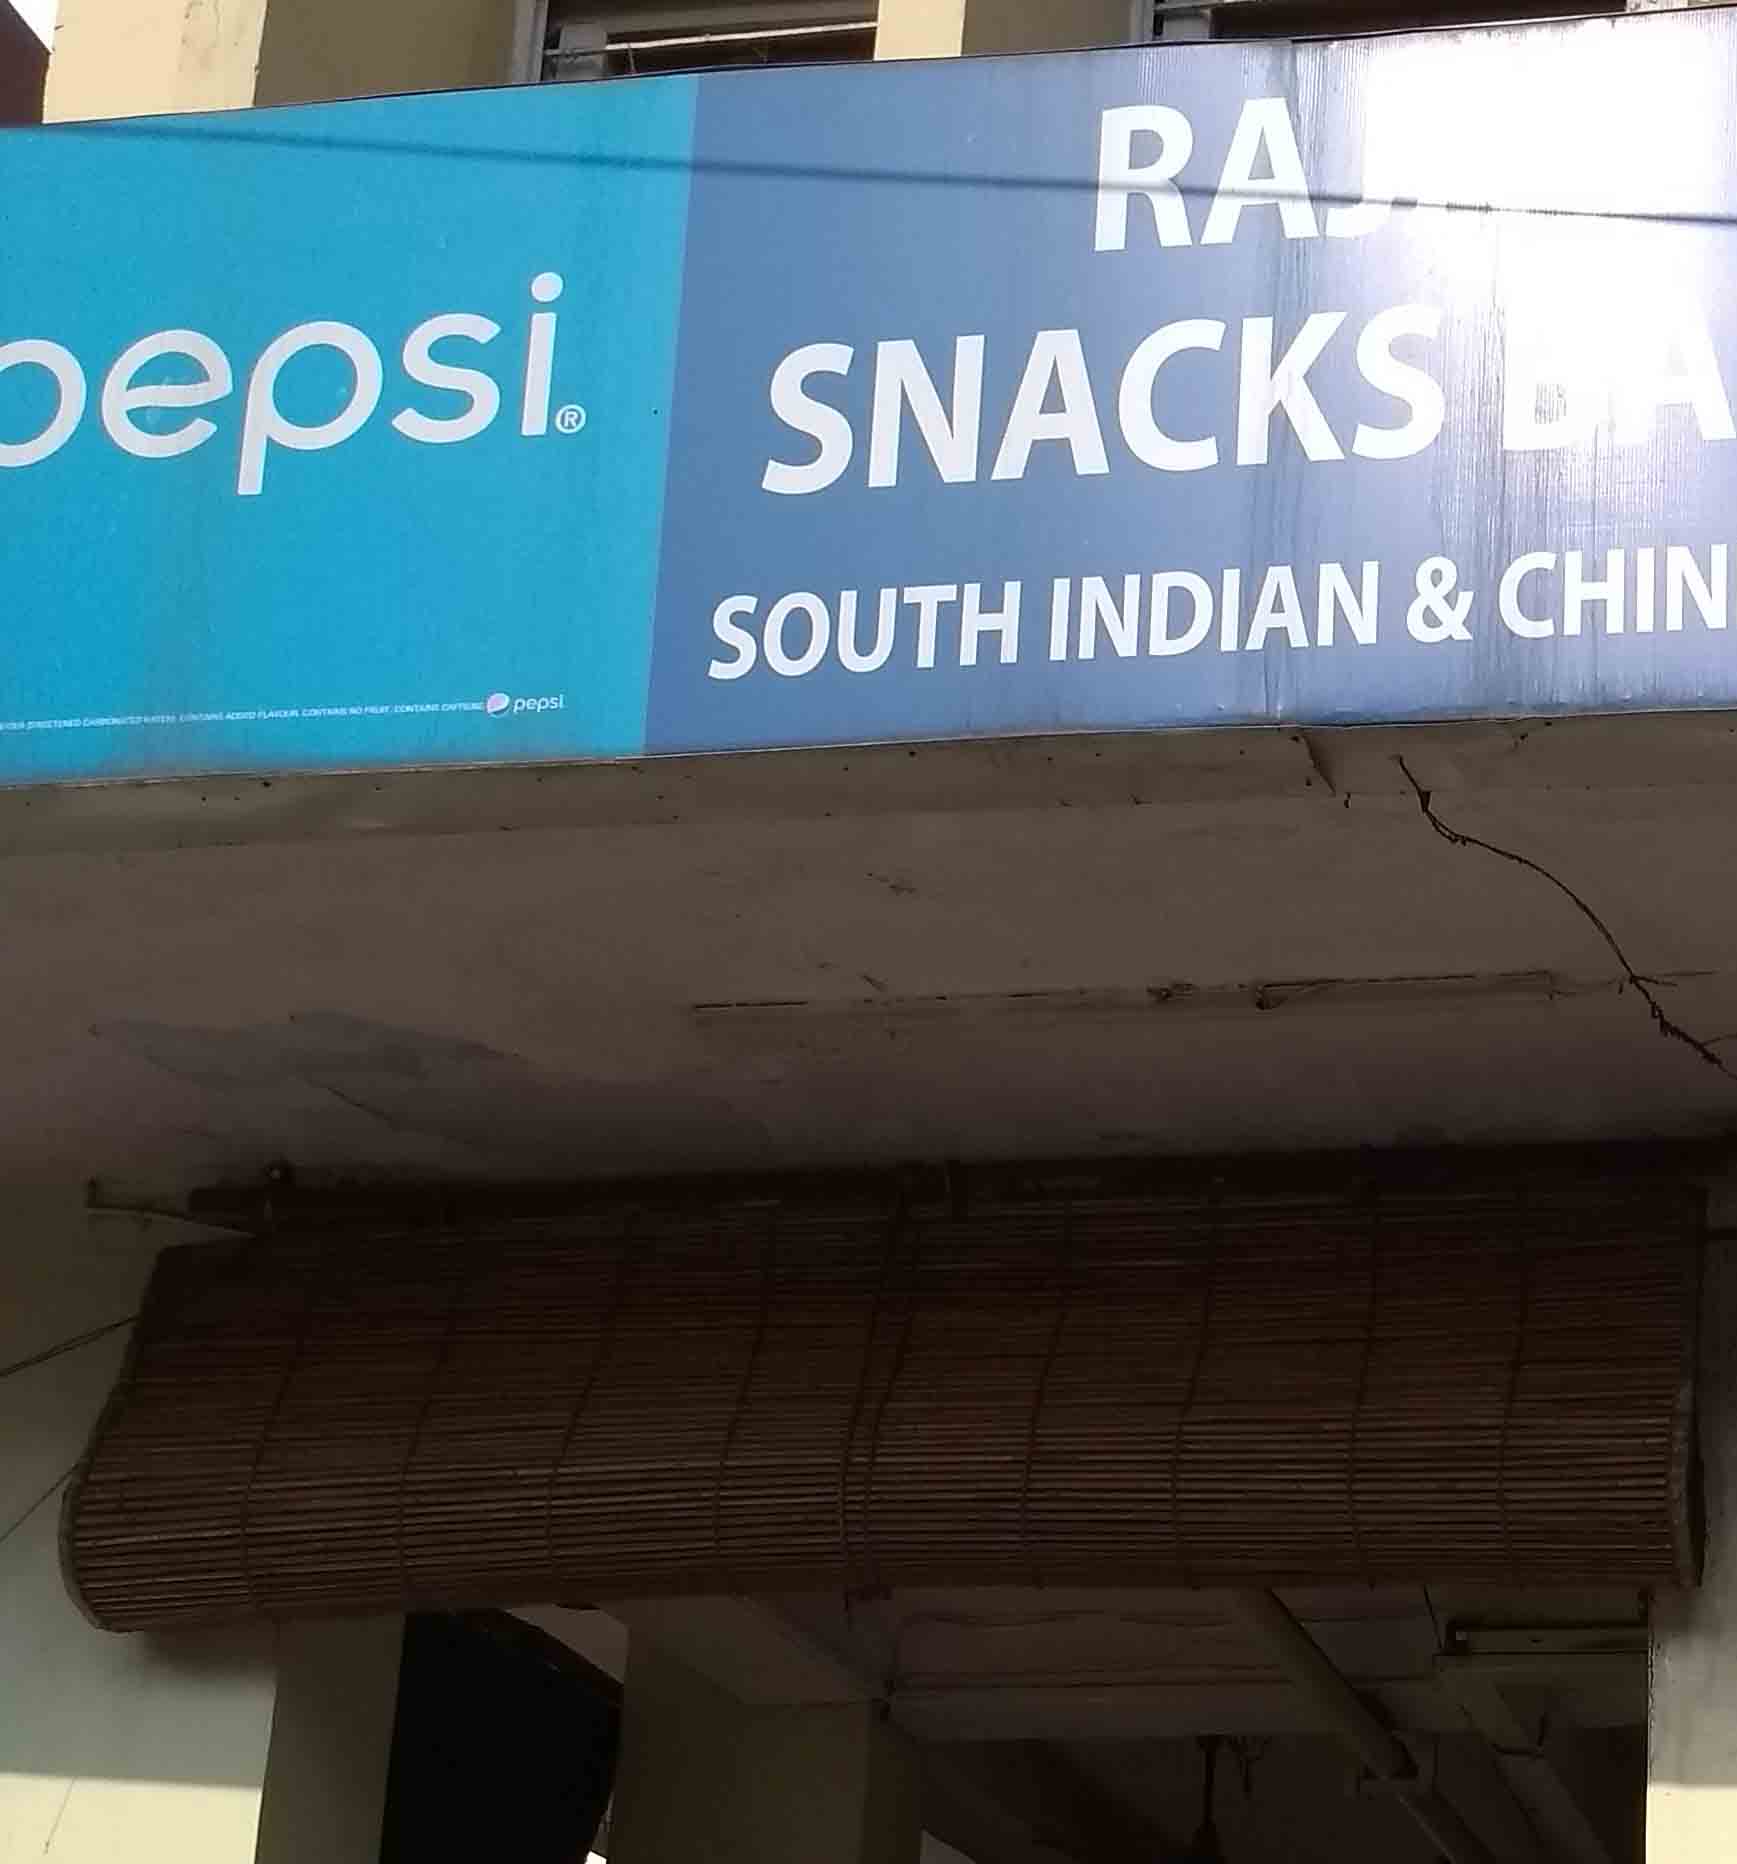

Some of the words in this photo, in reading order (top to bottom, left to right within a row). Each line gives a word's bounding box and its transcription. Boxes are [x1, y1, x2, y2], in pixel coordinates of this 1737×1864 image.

[1094, 96, 1400, 252] RA
[760, 304, 1447, 497] SNACKS
[706, 580, 1022, 681] SOUTH
[1047, 560, 1380, 662] INDIAN
[1405, 555, 1474, 643] &
[513, 694, 563, 714] pepsi
